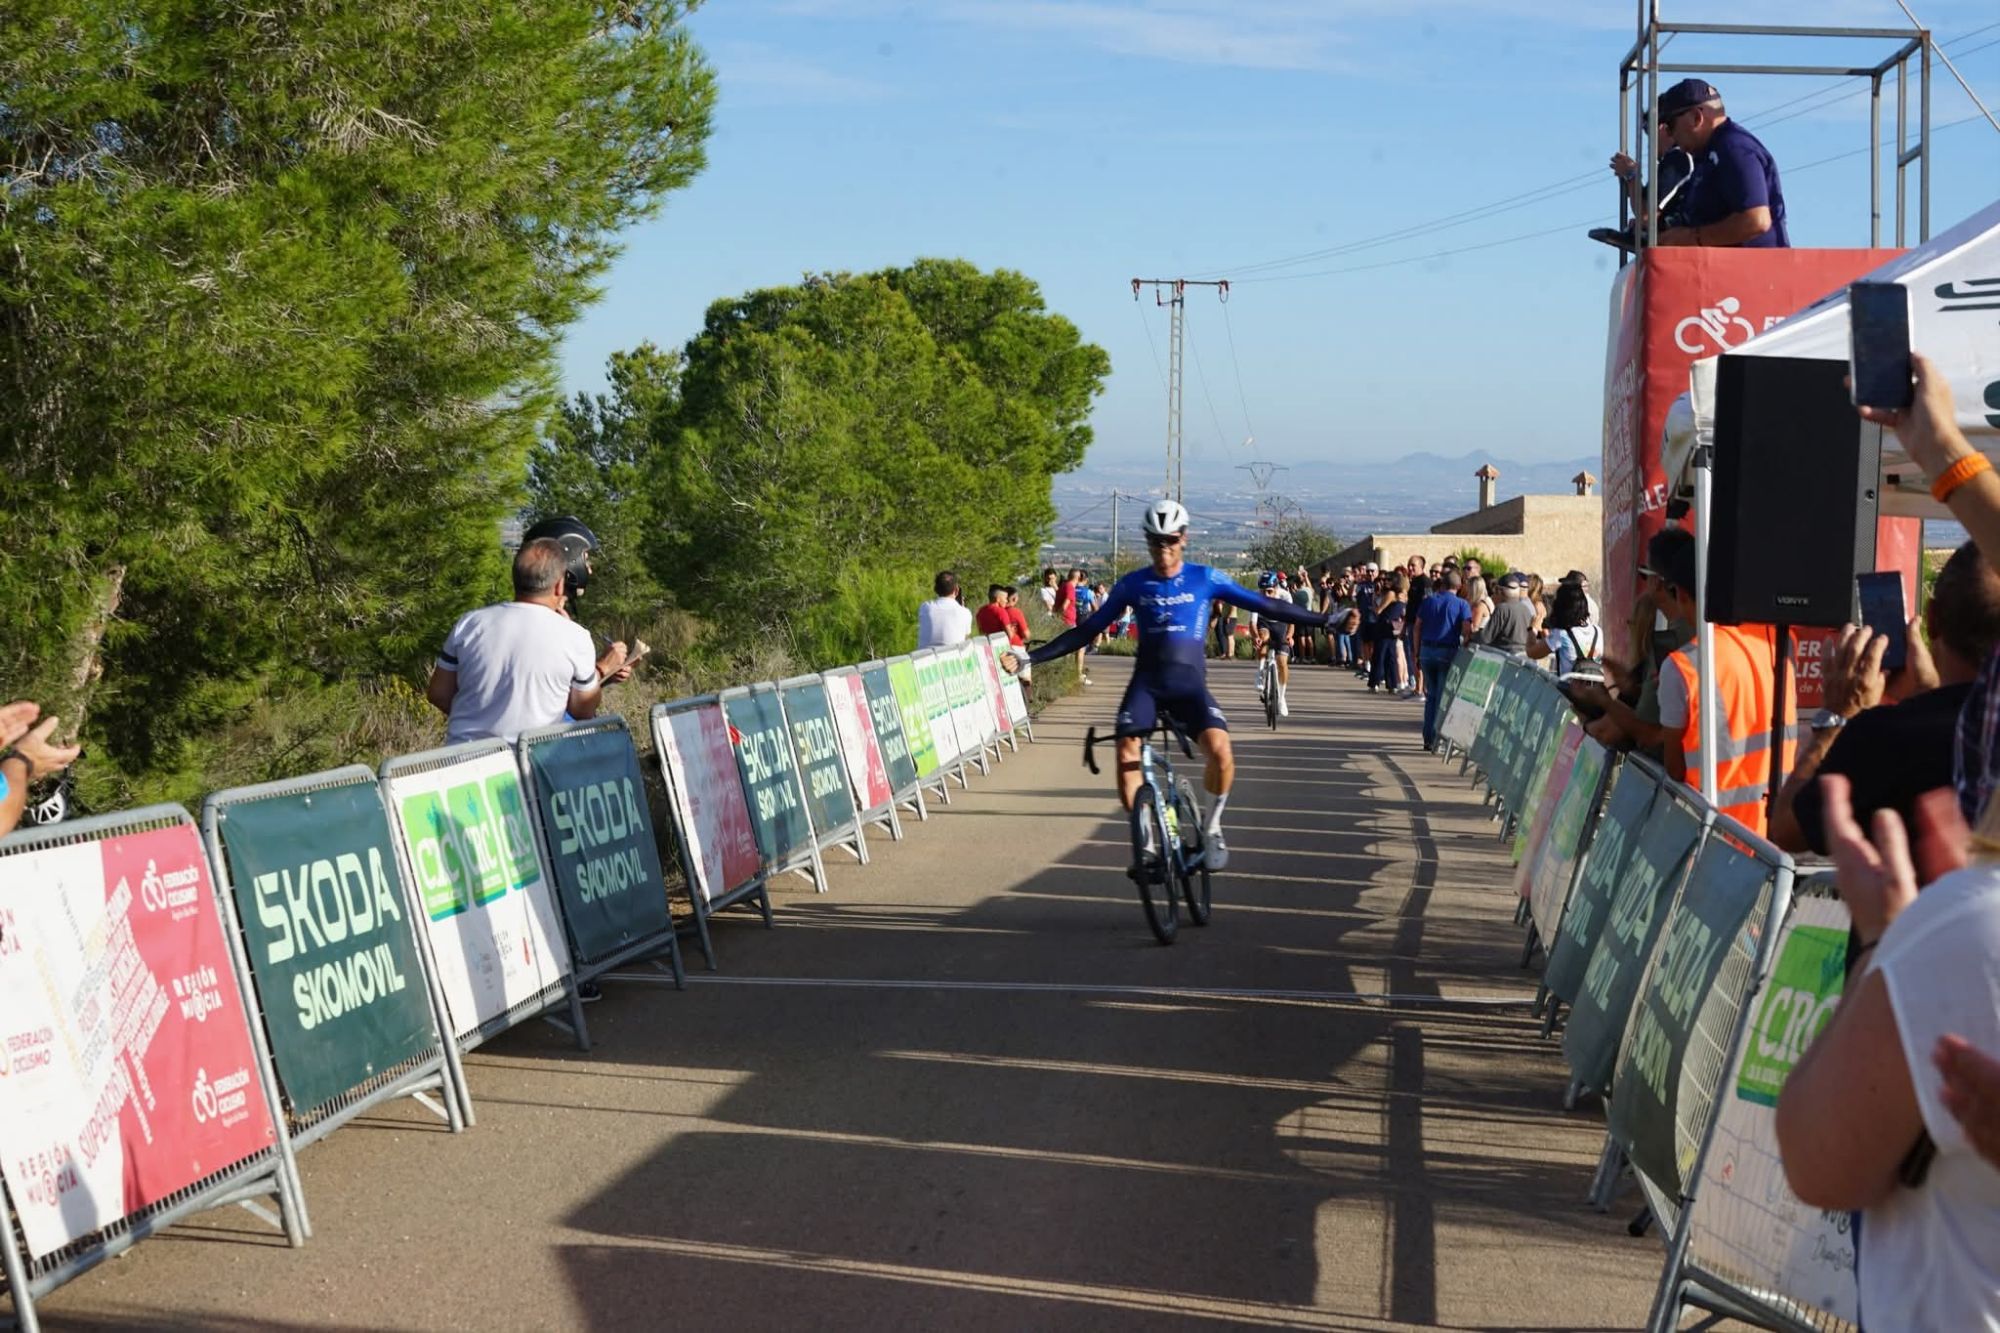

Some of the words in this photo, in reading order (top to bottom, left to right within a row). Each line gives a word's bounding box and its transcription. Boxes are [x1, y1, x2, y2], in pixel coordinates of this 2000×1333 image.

[740, 727, 792, 784] SKODA
[793, 717, 838, 765] SKODA
[551, 777, 644, 855] SKODA
[576, 847, 648, 904] SKOMOVIL
[253, 847, 401, 965] SKODA
[172, 964, 218, 997] REGIÓN
[293, 943, 405, 1030] SKOMOVIL
